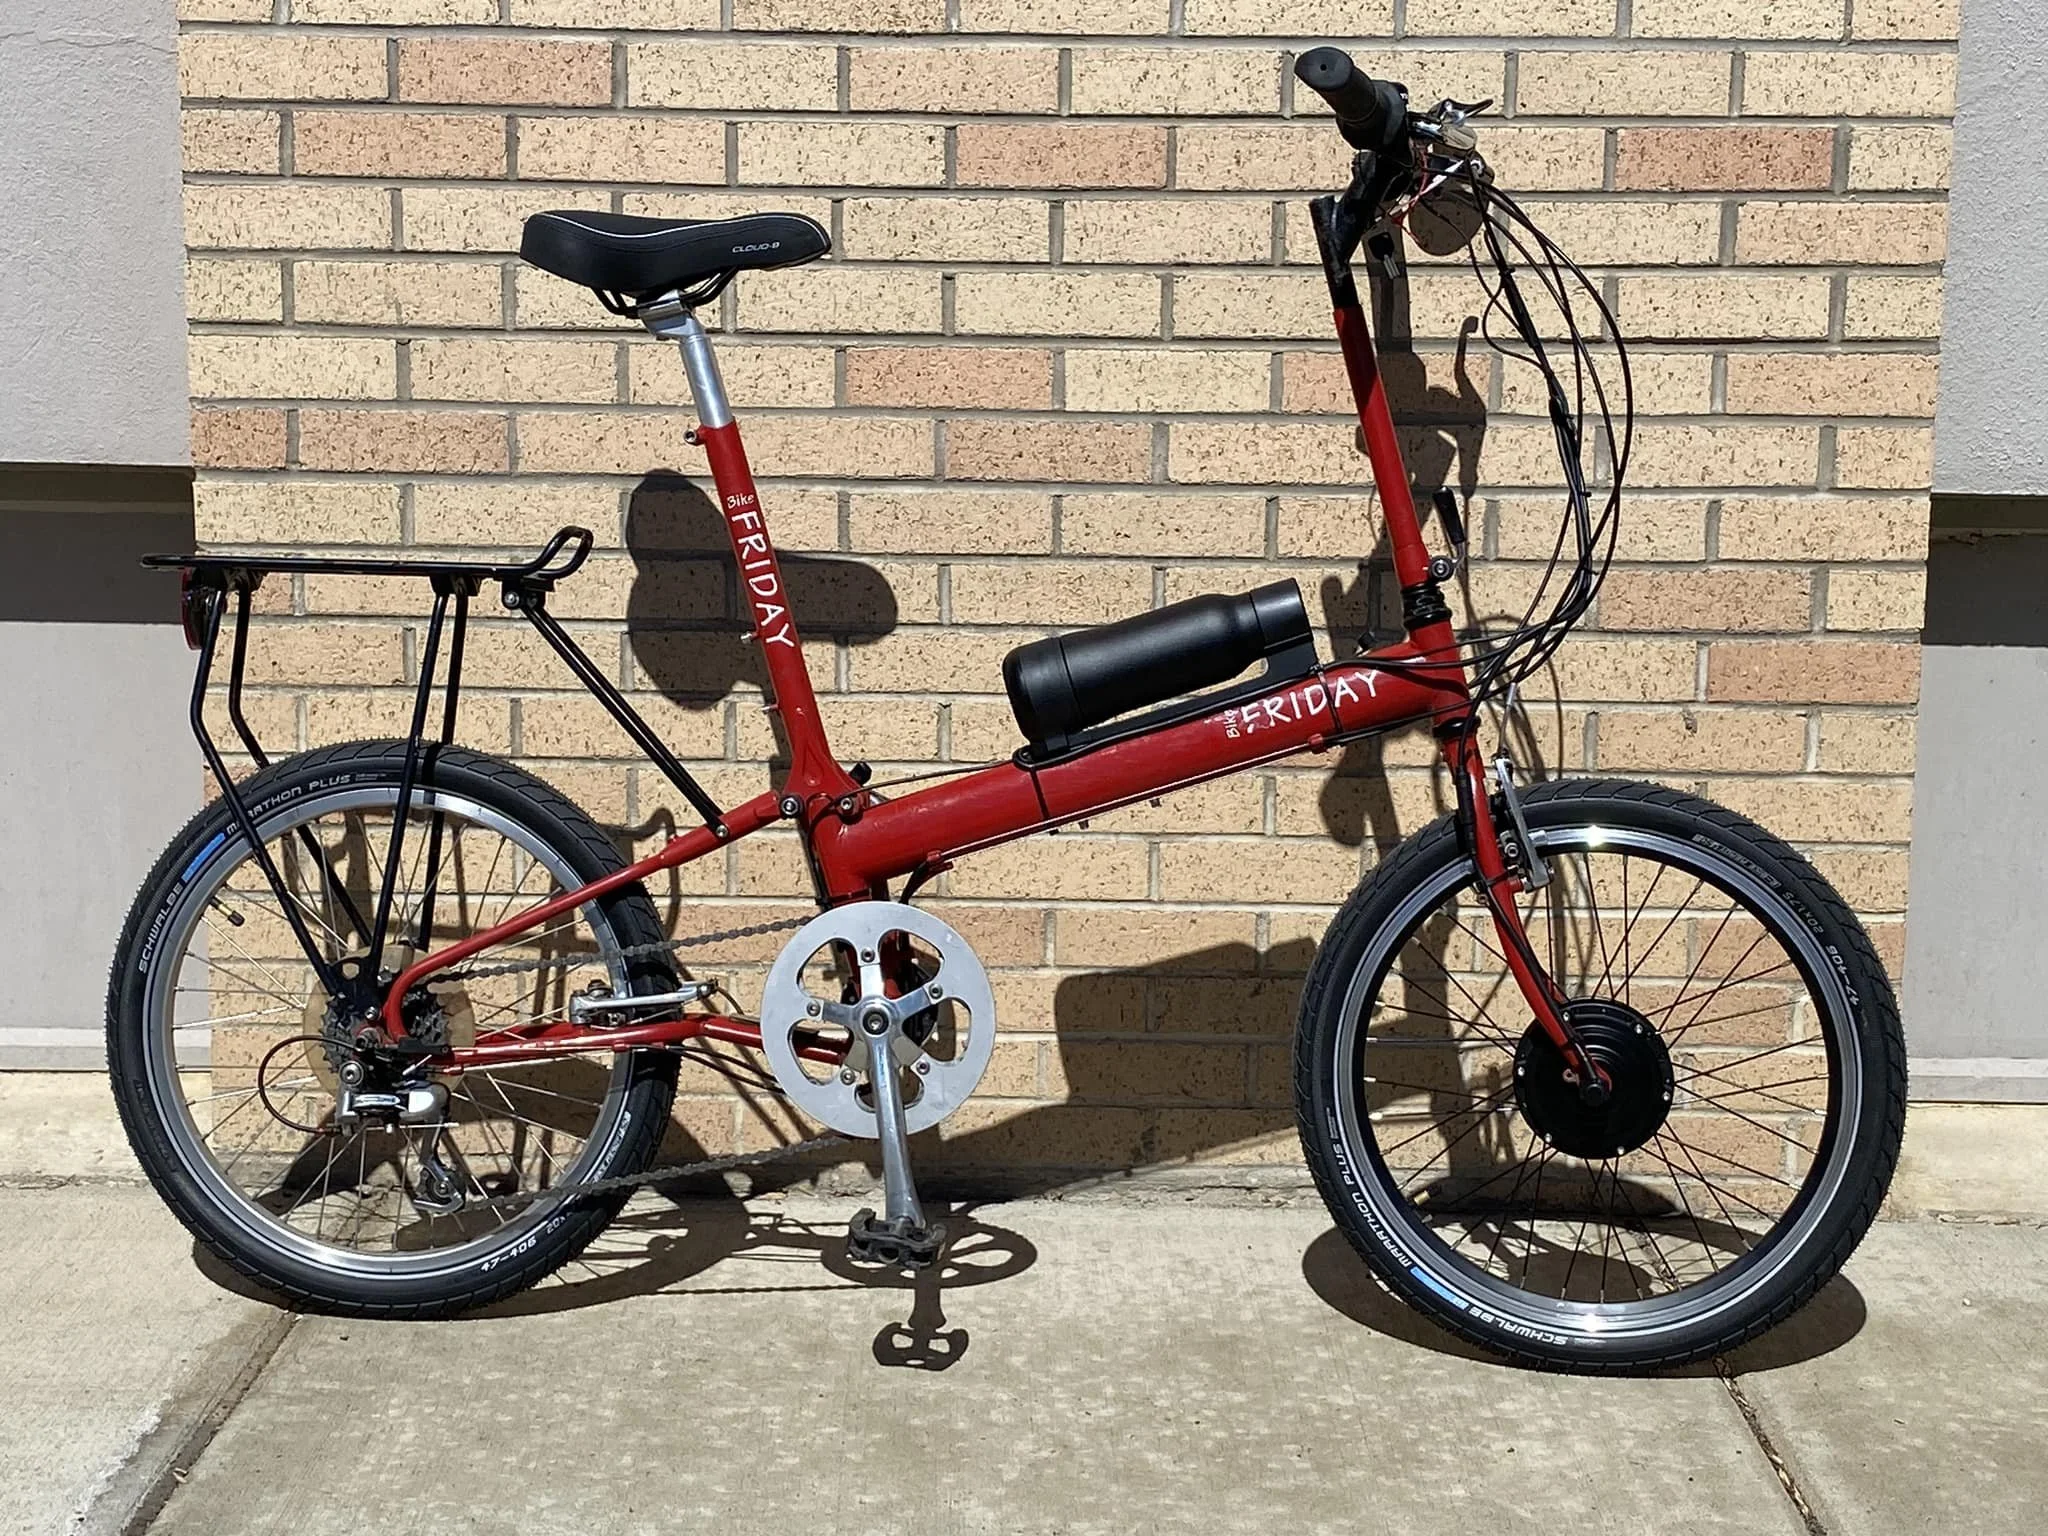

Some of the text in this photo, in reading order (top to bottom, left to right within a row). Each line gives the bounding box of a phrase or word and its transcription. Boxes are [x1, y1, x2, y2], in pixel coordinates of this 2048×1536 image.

[731, 510, 795, 648] FRIDAY
[1240, 669, 1378, 734] FRIDAY
[138, 882, 184, 974] SCHWALBE
[308, 774, 351, 791] PLUS
[481, 1235, 537, 1272] 47-406
[1332, 1143, 1569, 1346] SCHWALBE MARATHON PLUS
